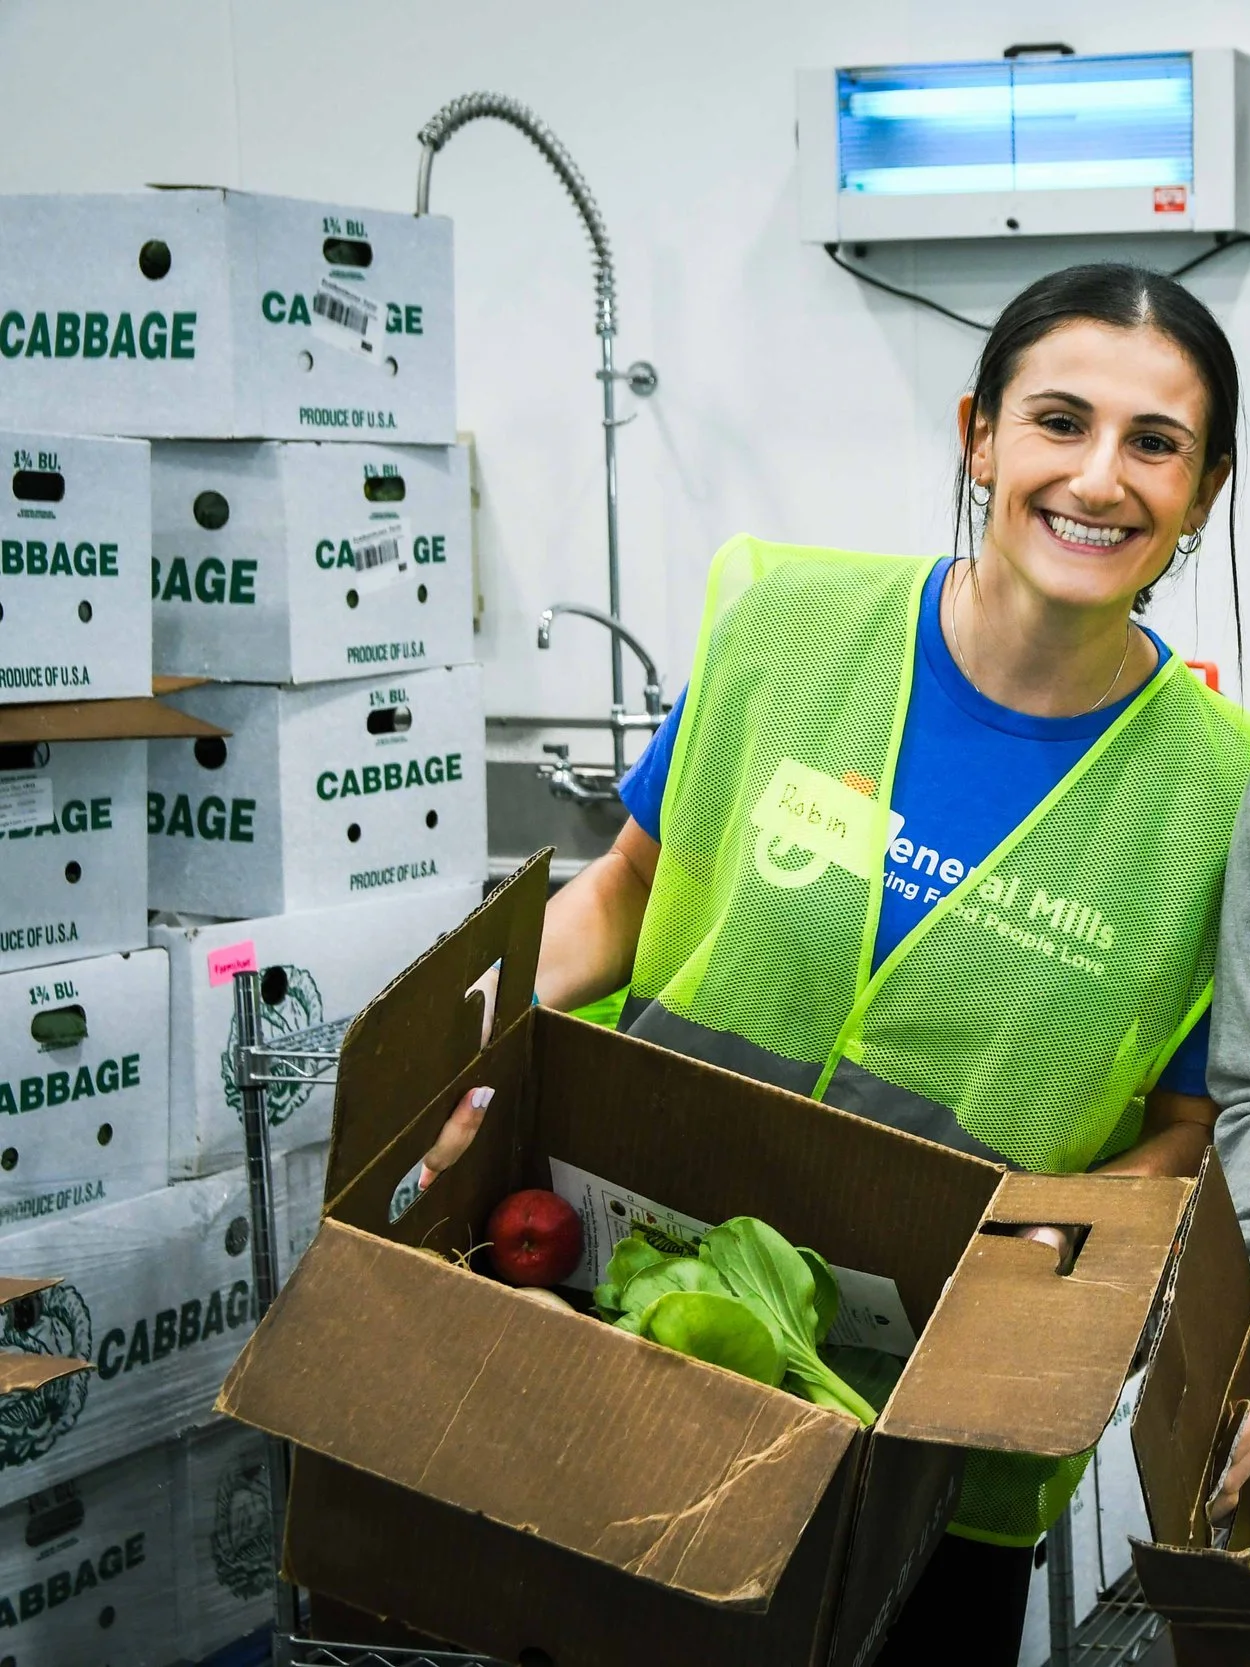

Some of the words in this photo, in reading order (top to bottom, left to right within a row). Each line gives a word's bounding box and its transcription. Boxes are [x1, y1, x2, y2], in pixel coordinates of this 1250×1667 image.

[346, 219, 369, 238] BU.
[262, 290, 423, 335] CAGE
[0, 310, 197, 359] CABBAGE
[299, 406, 349, 426] PRODUCE
[352, 409, 365, 427] OF
[38, 452, 61, 470] BU.
[315, 536, 446, 570] CAGE
[347, 644, 388, 664] PRODUCE
[389, 642, 400, 660] OF
[45, 666, 58, 686] OF
[389, 688, 409, 704] BU.
[316, 753, 462, 801] CABBAGE
[350, 867, 395, 891] PRODUCE
[397, 865, 409, 881] OF
[1027, 888, 1114, 950] Mills
[27, 926, 42, 948] OF
[984, 913, 1055, 956] People
[1060, 944, 1105, 976] Love
[54, 980, 79, 1000] BU.
[56, 1189, 72, 1210] OF
